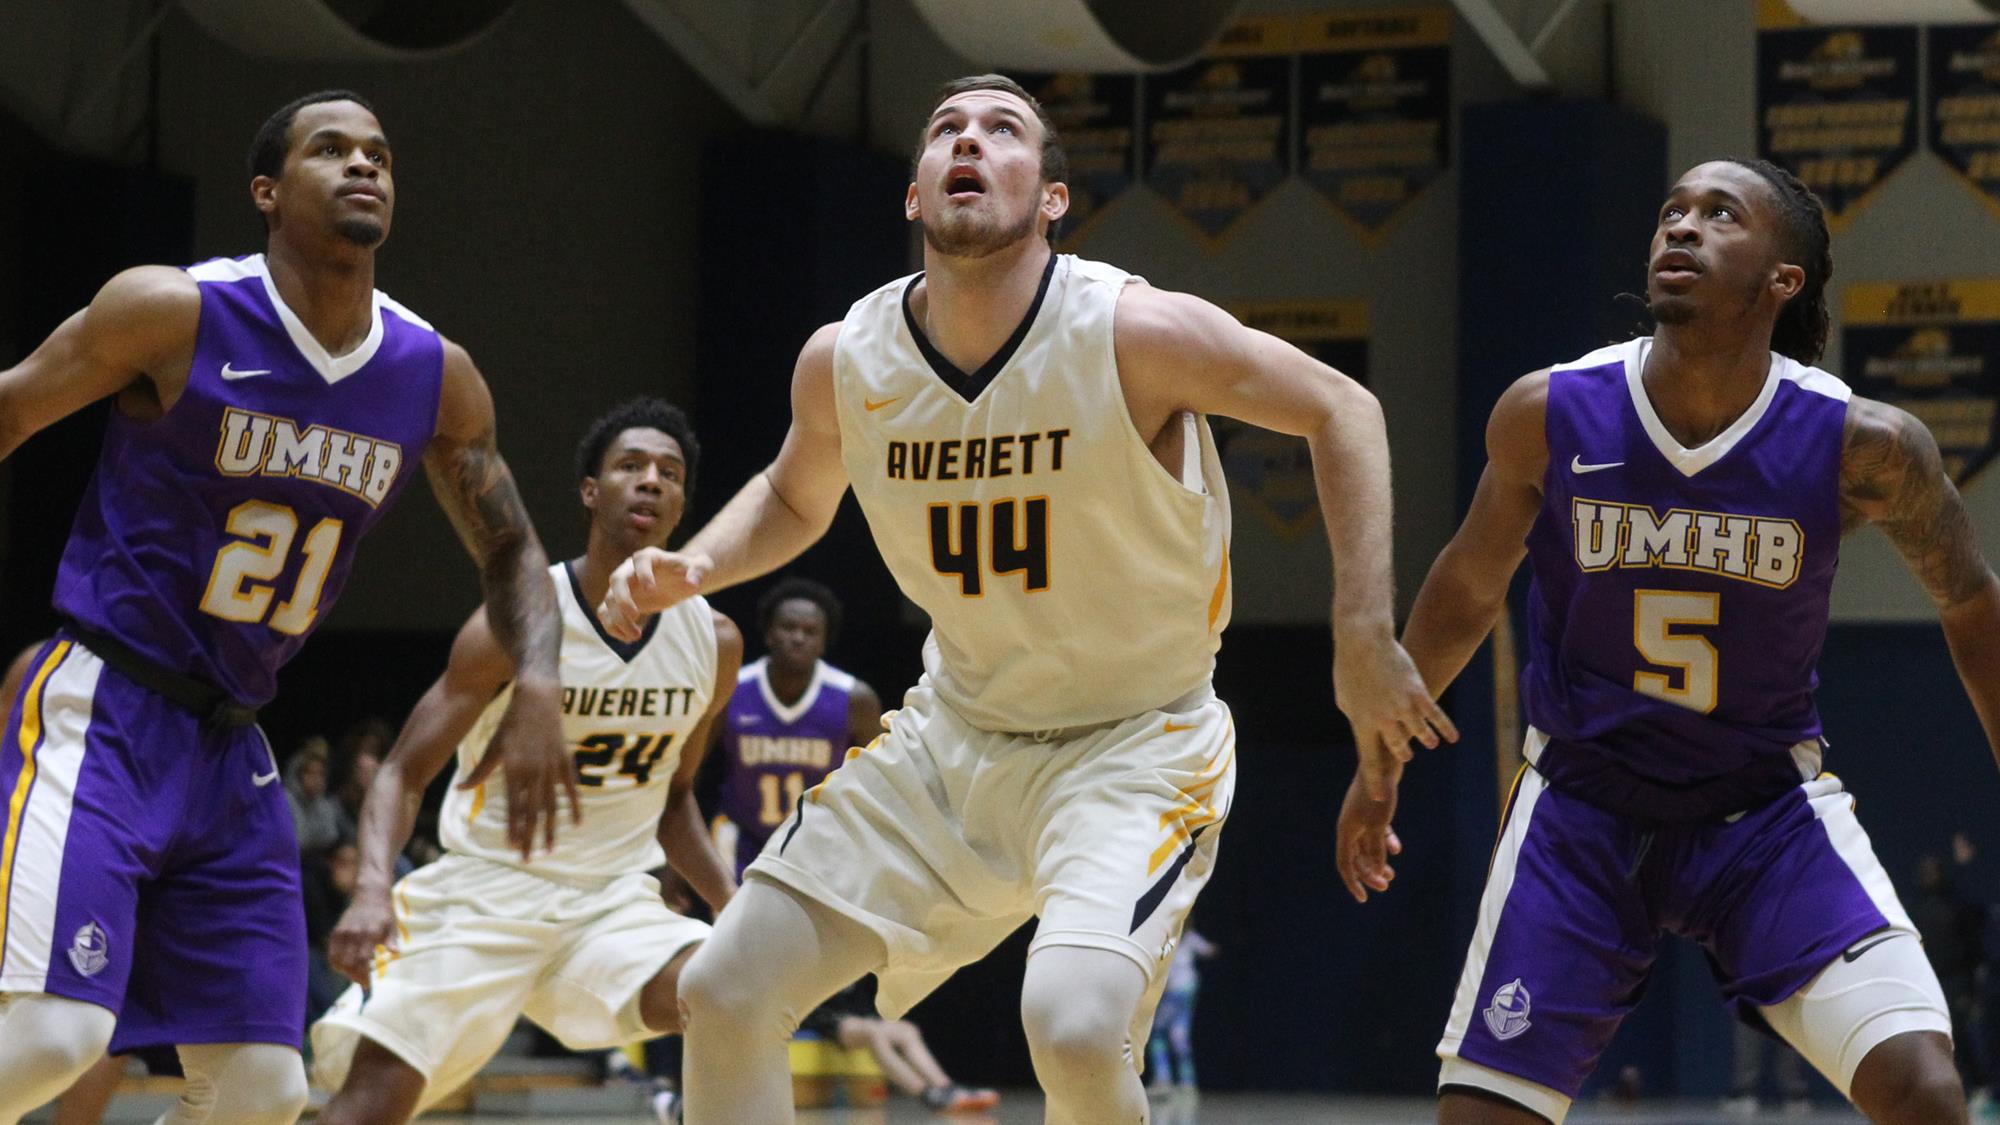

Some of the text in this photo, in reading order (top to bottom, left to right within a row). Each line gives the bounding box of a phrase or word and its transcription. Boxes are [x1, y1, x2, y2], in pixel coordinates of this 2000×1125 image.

[215, 406, 403, 509] UMHB
[887, 429, 1070, 480] AVERETT
[199, 499, 344, 635] 21
[927, 495, 1050, 598] 44
[1572, 496, 1805, 589] UMHB
[1633, 589, 1720, 714] 5
[574, 731, 677, 788] 24
[738, 735, 831, 767] UMHB
